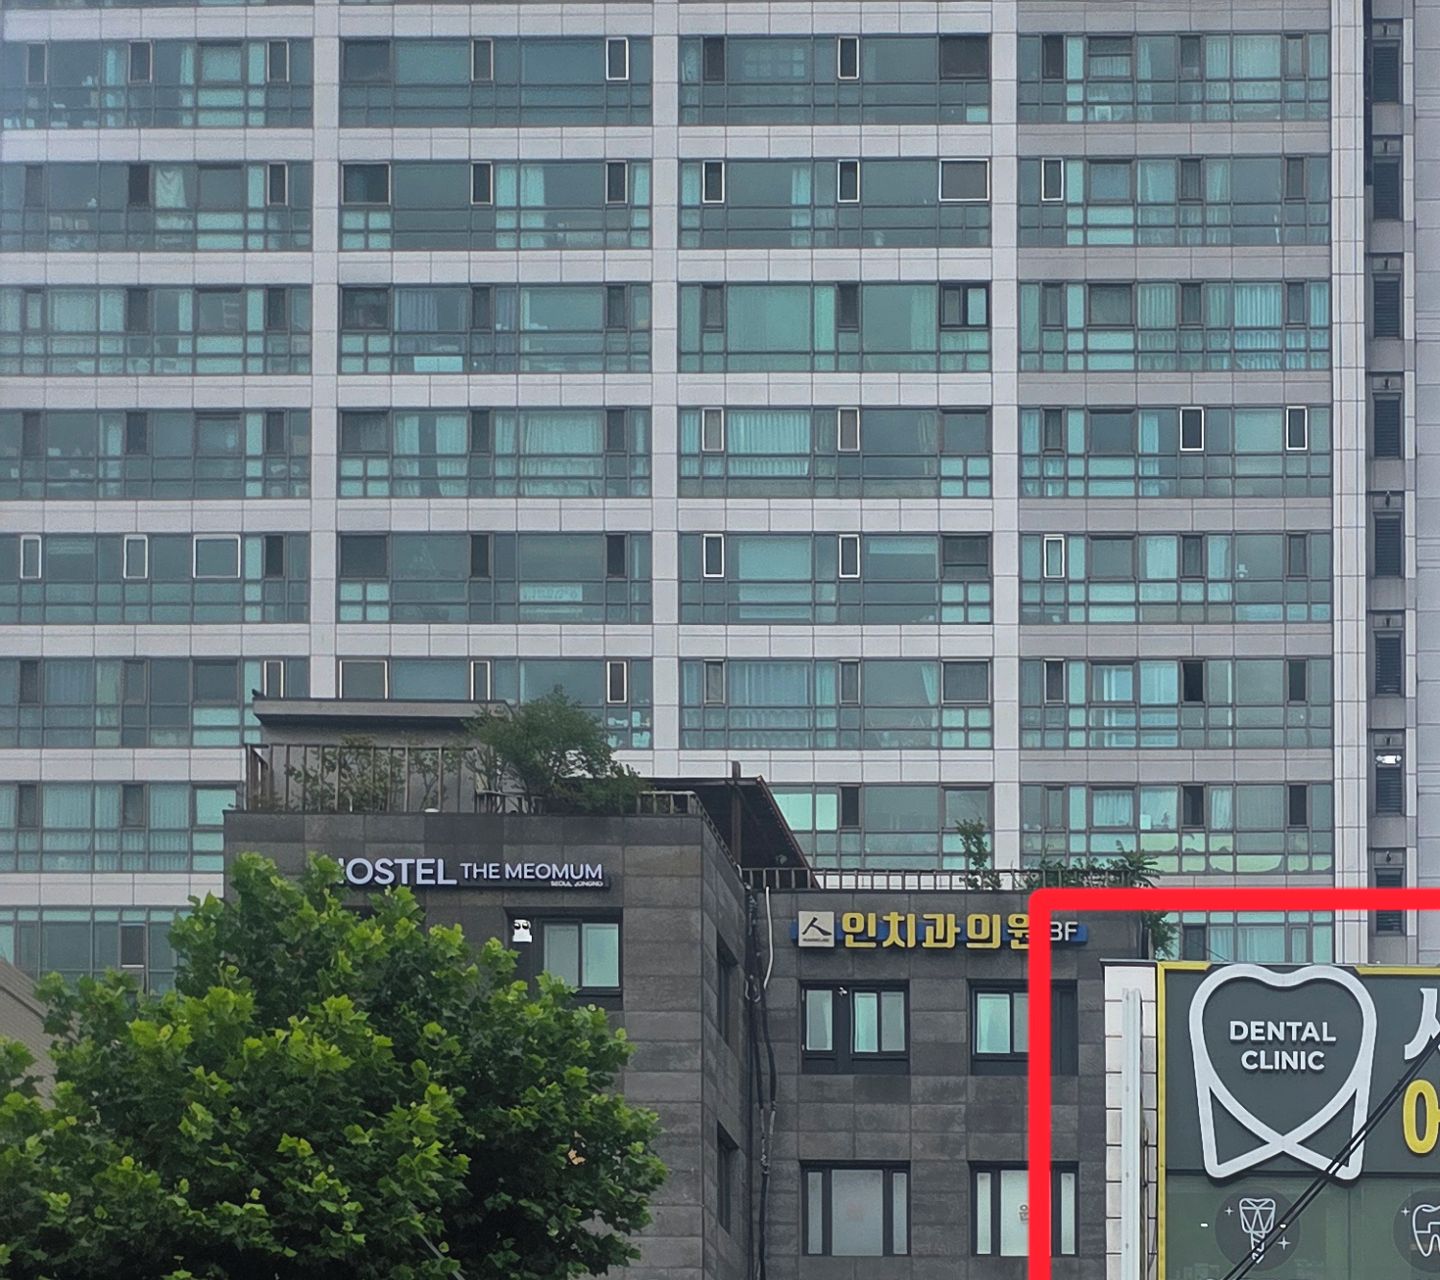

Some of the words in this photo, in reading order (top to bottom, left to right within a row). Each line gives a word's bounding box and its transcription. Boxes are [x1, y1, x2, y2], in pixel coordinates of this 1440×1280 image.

[461, 863, 500, 879] THE
[505, 863, 602, 880] MEOMUM
[1230, 1020, 1337, 1043] DENTAL
[1241, 1050, 1326, 1071] CLINIC
